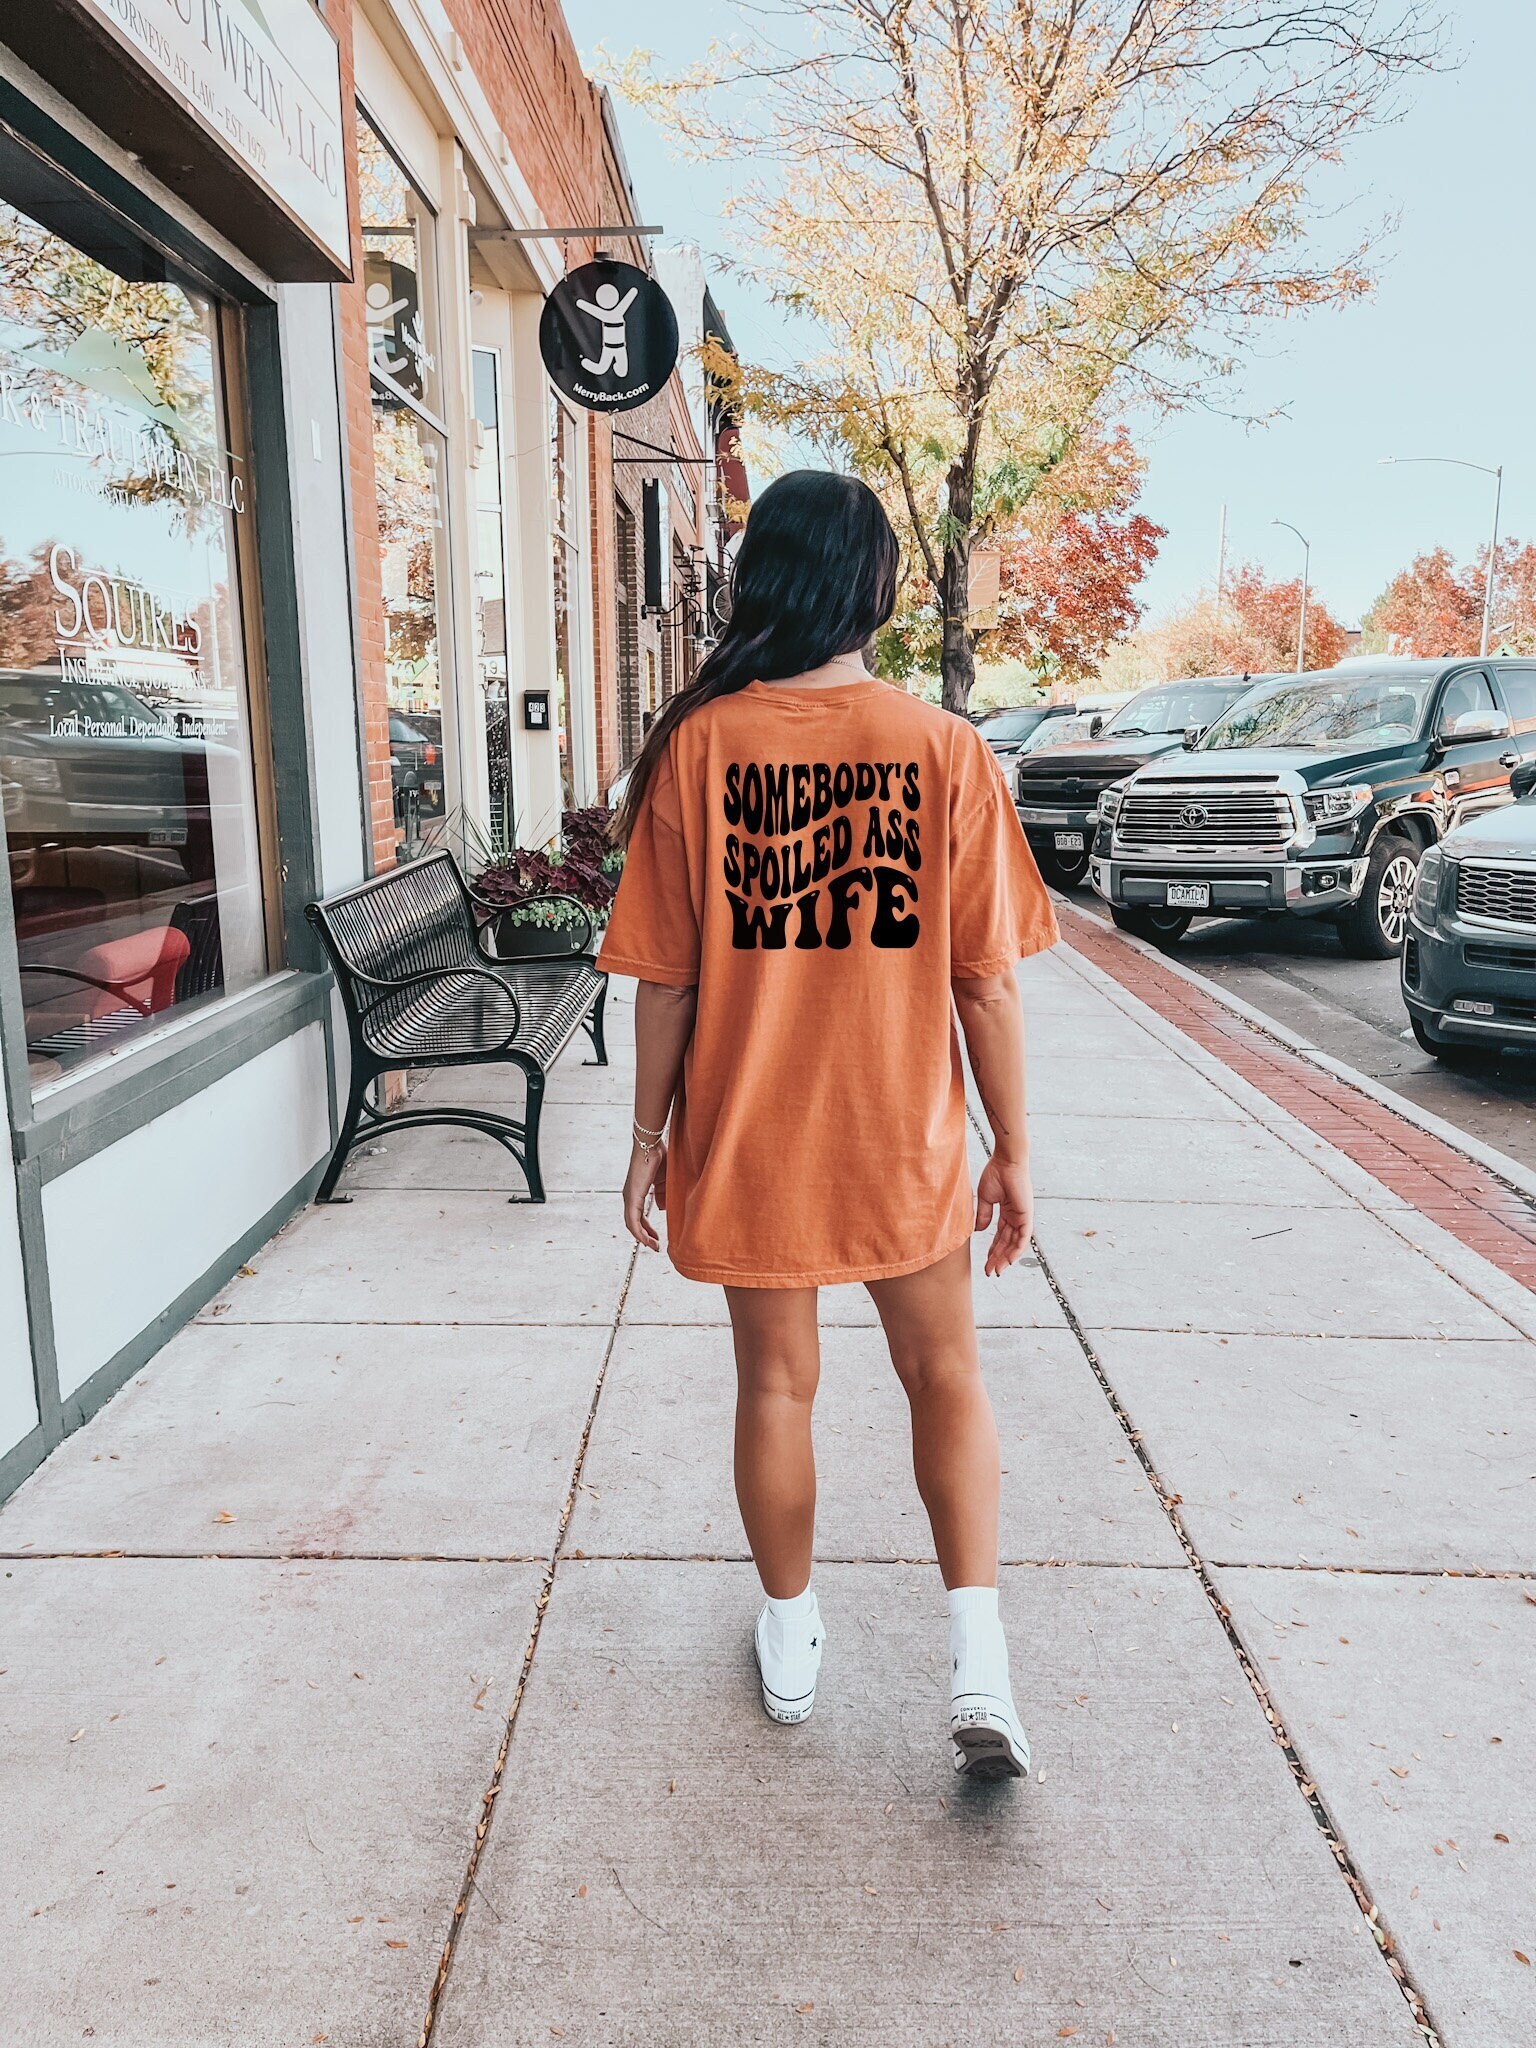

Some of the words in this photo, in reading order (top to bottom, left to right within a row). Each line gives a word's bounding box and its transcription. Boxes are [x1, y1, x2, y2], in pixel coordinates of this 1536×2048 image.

[109, 0, 171, 67] ORNEYS
[173, 52, 188, 86] AT
[191, 69, 215, 113] LAW
[225, 106, 245, 147] EST.
[167, 0, 293, 156] TWEIN,
[296, 102, 338, 198] LLC
[573, 382, 650, 402] MerryBack.com
[31, 391, 48, 432] &
[50, 394, 206, 506] TRAUTWEIN,
[208, 462, 246, 515] LLC
[50, 543, 202, 655] SQUIRES
[50, 715, 82, 738] Local.
[84, 716, 128, 738] Personal.
[129, 715, 180, 743] Dependable.
[182, 717, 228, 740] Independent.
[724, 762, 921, 837] SOMEBODY'S
[724, 816, 853, 901] SPOILED
[863, 806, 922, 872] ASS
[725, 866, 920, 950] WIFE
